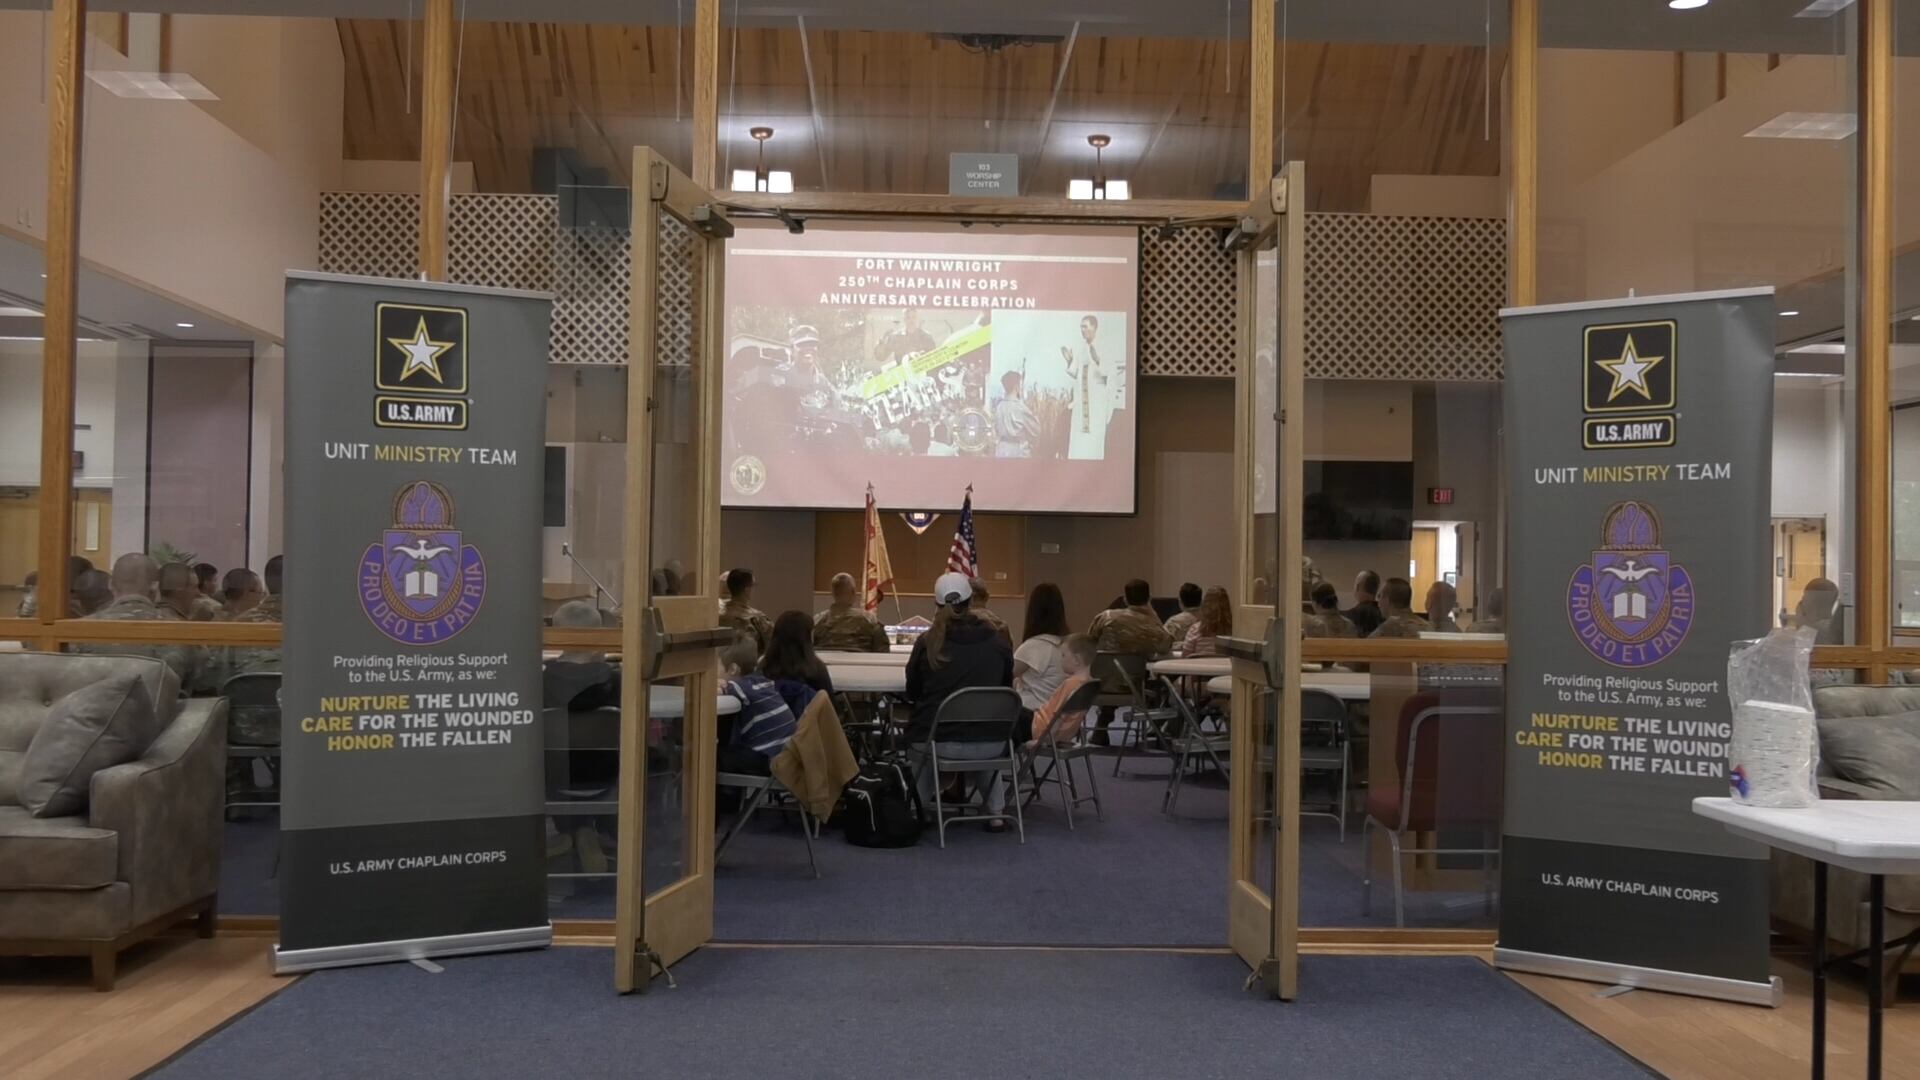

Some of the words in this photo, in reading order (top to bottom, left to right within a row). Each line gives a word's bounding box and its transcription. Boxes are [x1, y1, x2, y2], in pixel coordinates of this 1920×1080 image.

[966, 172, 1002, 180] WORSHIP
[856, 258, 894, 270] FORT
[900, 260, 1001, 272] WAINWRIGHT
[838, 275, 880, 287] 250TH
[885, 276, 961, 289] CHAPLAIN
[967, 279, 1018, 290] CORPS
[820, 293, 928, 306] ANNIVERSARY
[933, 295, 1036, 308] CELEBRATION
[388, 403, 413, 420] U.S.
[415, 404, 455, 422] ARMY
[1596, 425, 1621, 441] U.S.
[1623, 423, 1663, 440] ARMY
[325, 442, 370, 460] UNIT
[374, 444, 463, 463] MINISTRY
[468, 448, 517, 465] TEAM
[1535, 467, 1578, 484] UNIT
[1583, 465, 1670, 483] MINISTRY
[1676, 463, 1731, 480] TEAM
[363, 561, 382, 600] PRO
[447, 562, 483, 631] PATRIA
[372, 602, 408, 635] DEO
[1572, 582, 1590, 621] PRO
[1581, 624, 1616, 657] DEO
[1622, 645, 1646, 662] ET
[1653, 583, 1690, 655] PATRIA
[414, 622, 438, 640] ET
[333, 655, 393, 669] Providing
[397, 654, 454, 669] Religious
[458, 653, 508, 667] Support
[348, 671, 362, 683] to
[365, 671, 386, 682] the
[390, 670, 414, 682] U.S.
[417, 669, 455, 683] Army,
[458, 670, 472, 680] as
[476, 670, 497, 680] we:
[1543, 674, 1603, 690] Providing
[1606, 676, 1663, 692] Religious
[1666, 679, 1719, 694] Support
[320, 695, 410, 712] NURTURE
[415, 694, 452, 709] THE
[459, 692, 519, 708] LIVING
[1558, 689, 1571, 701] to
[1574, 690, 1595, 702] the
[1599, 691, 1622, 704] U.S.
[1626, 693, 1663, 708] Army,
[1667, 697, 1681, 708] as
[1684, 697, 1707, 708] we:
[301, 716, 353, 732] CARE
[359, 715, 395, 730] FOR
[402, 713, 439, 728] THE
[444, 710, 534, 727] WOUNDED
[1531, 713, 1618, 732] NURTURE
[1624, 718, 1661, 734] THE
[1667, 720, 1731, 738] LIVING
[328, 734, 394, 751] HONOR
[400, 732, 437, 748] THE
[442, 729, 512, 746] FALLEN
[1515, 731, 1563, 747] CARE
[1569, 734, 1604, 750] FOR
[1610, 736, 1647, 752] THE
[1653, 738, 1729, 758] WOUND
[1538, 751, 1603, 769] HONOR
[1608, 755, 1645, 772] THE
[1651, 758, 1723, 778] FALLEN
[330, 863, 353, 875] U.S.
[357, 859, 395, 873] ARMY
[398, 854, 462, 869] CHAPLAIN
[465, 851, 506, 865] CORPS
[1541, 873, 1563, 886] U.S.
[1566, 876, 1603, 890] ARMY
[1606, 880, 1671, 898] CHAPLAIN
[1674, 888, 1719, 903] CORPS
